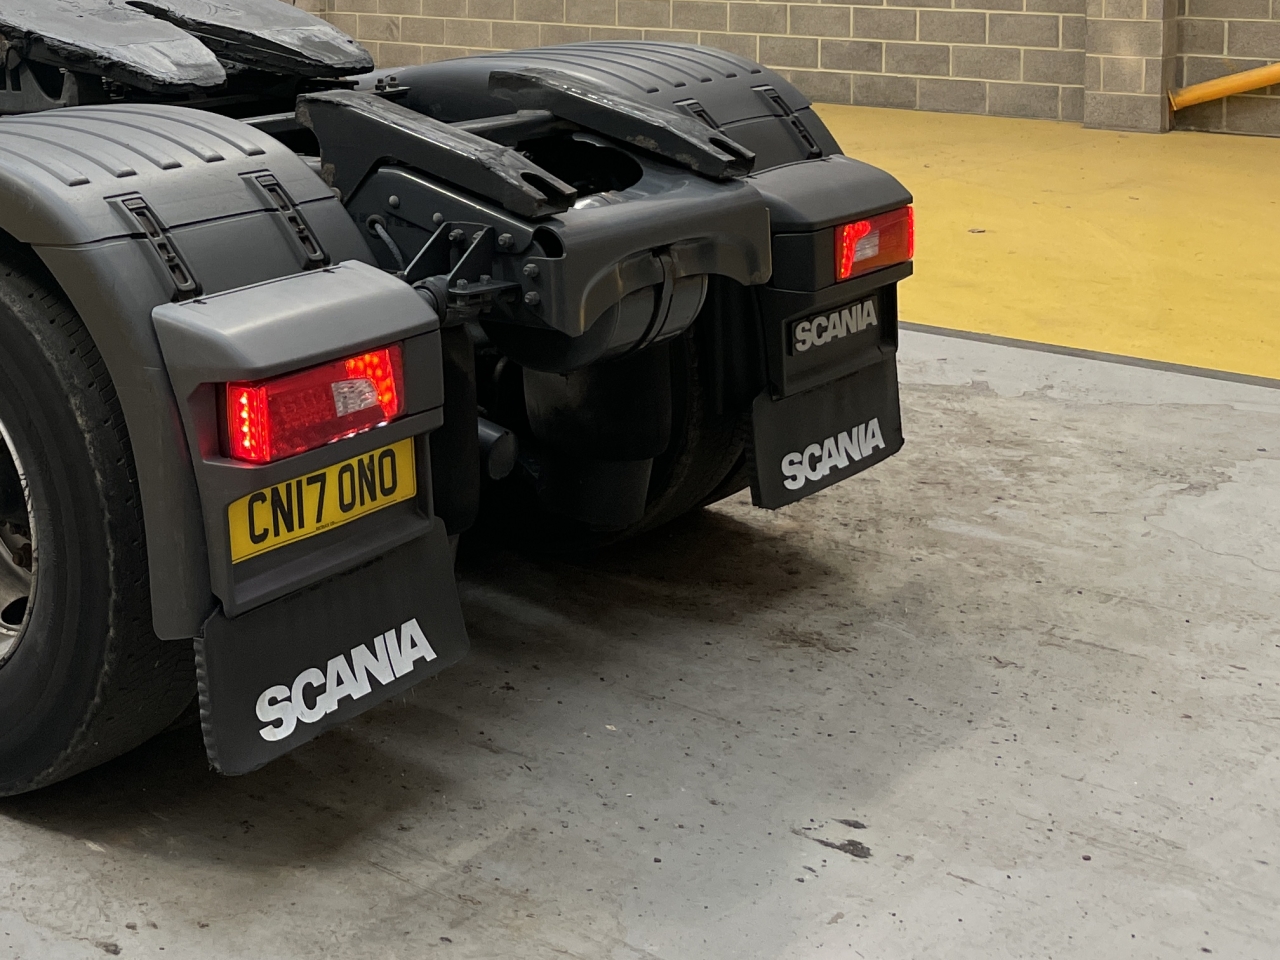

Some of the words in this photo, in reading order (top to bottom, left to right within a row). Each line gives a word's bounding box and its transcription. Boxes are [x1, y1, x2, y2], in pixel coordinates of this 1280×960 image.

[795, 300, 878, 352] SCANIA
[781, 417, 886, 490] SCANIA
[247, 471, 327, 545] CN17
[337, 448, 398, 514] ONO
[255, 618, 438, 742] SCANIA
